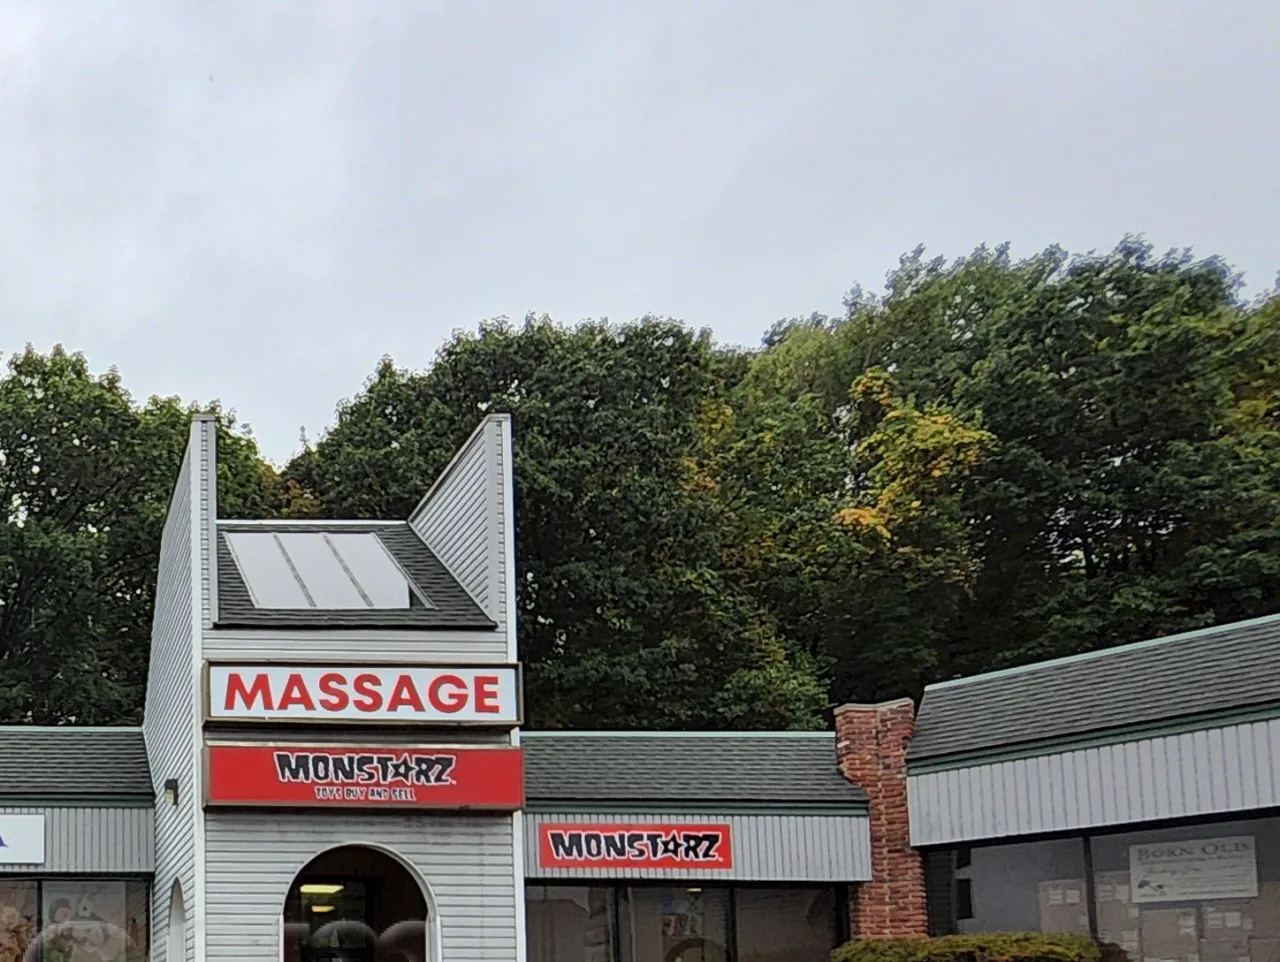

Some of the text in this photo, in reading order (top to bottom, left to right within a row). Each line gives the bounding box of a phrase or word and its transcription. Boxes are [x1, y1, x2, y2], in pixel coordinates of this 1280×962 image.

[224, 673, 500, 714] MASSAGE
[314, 787, 417, 800] TOYS BUY AND SELL
